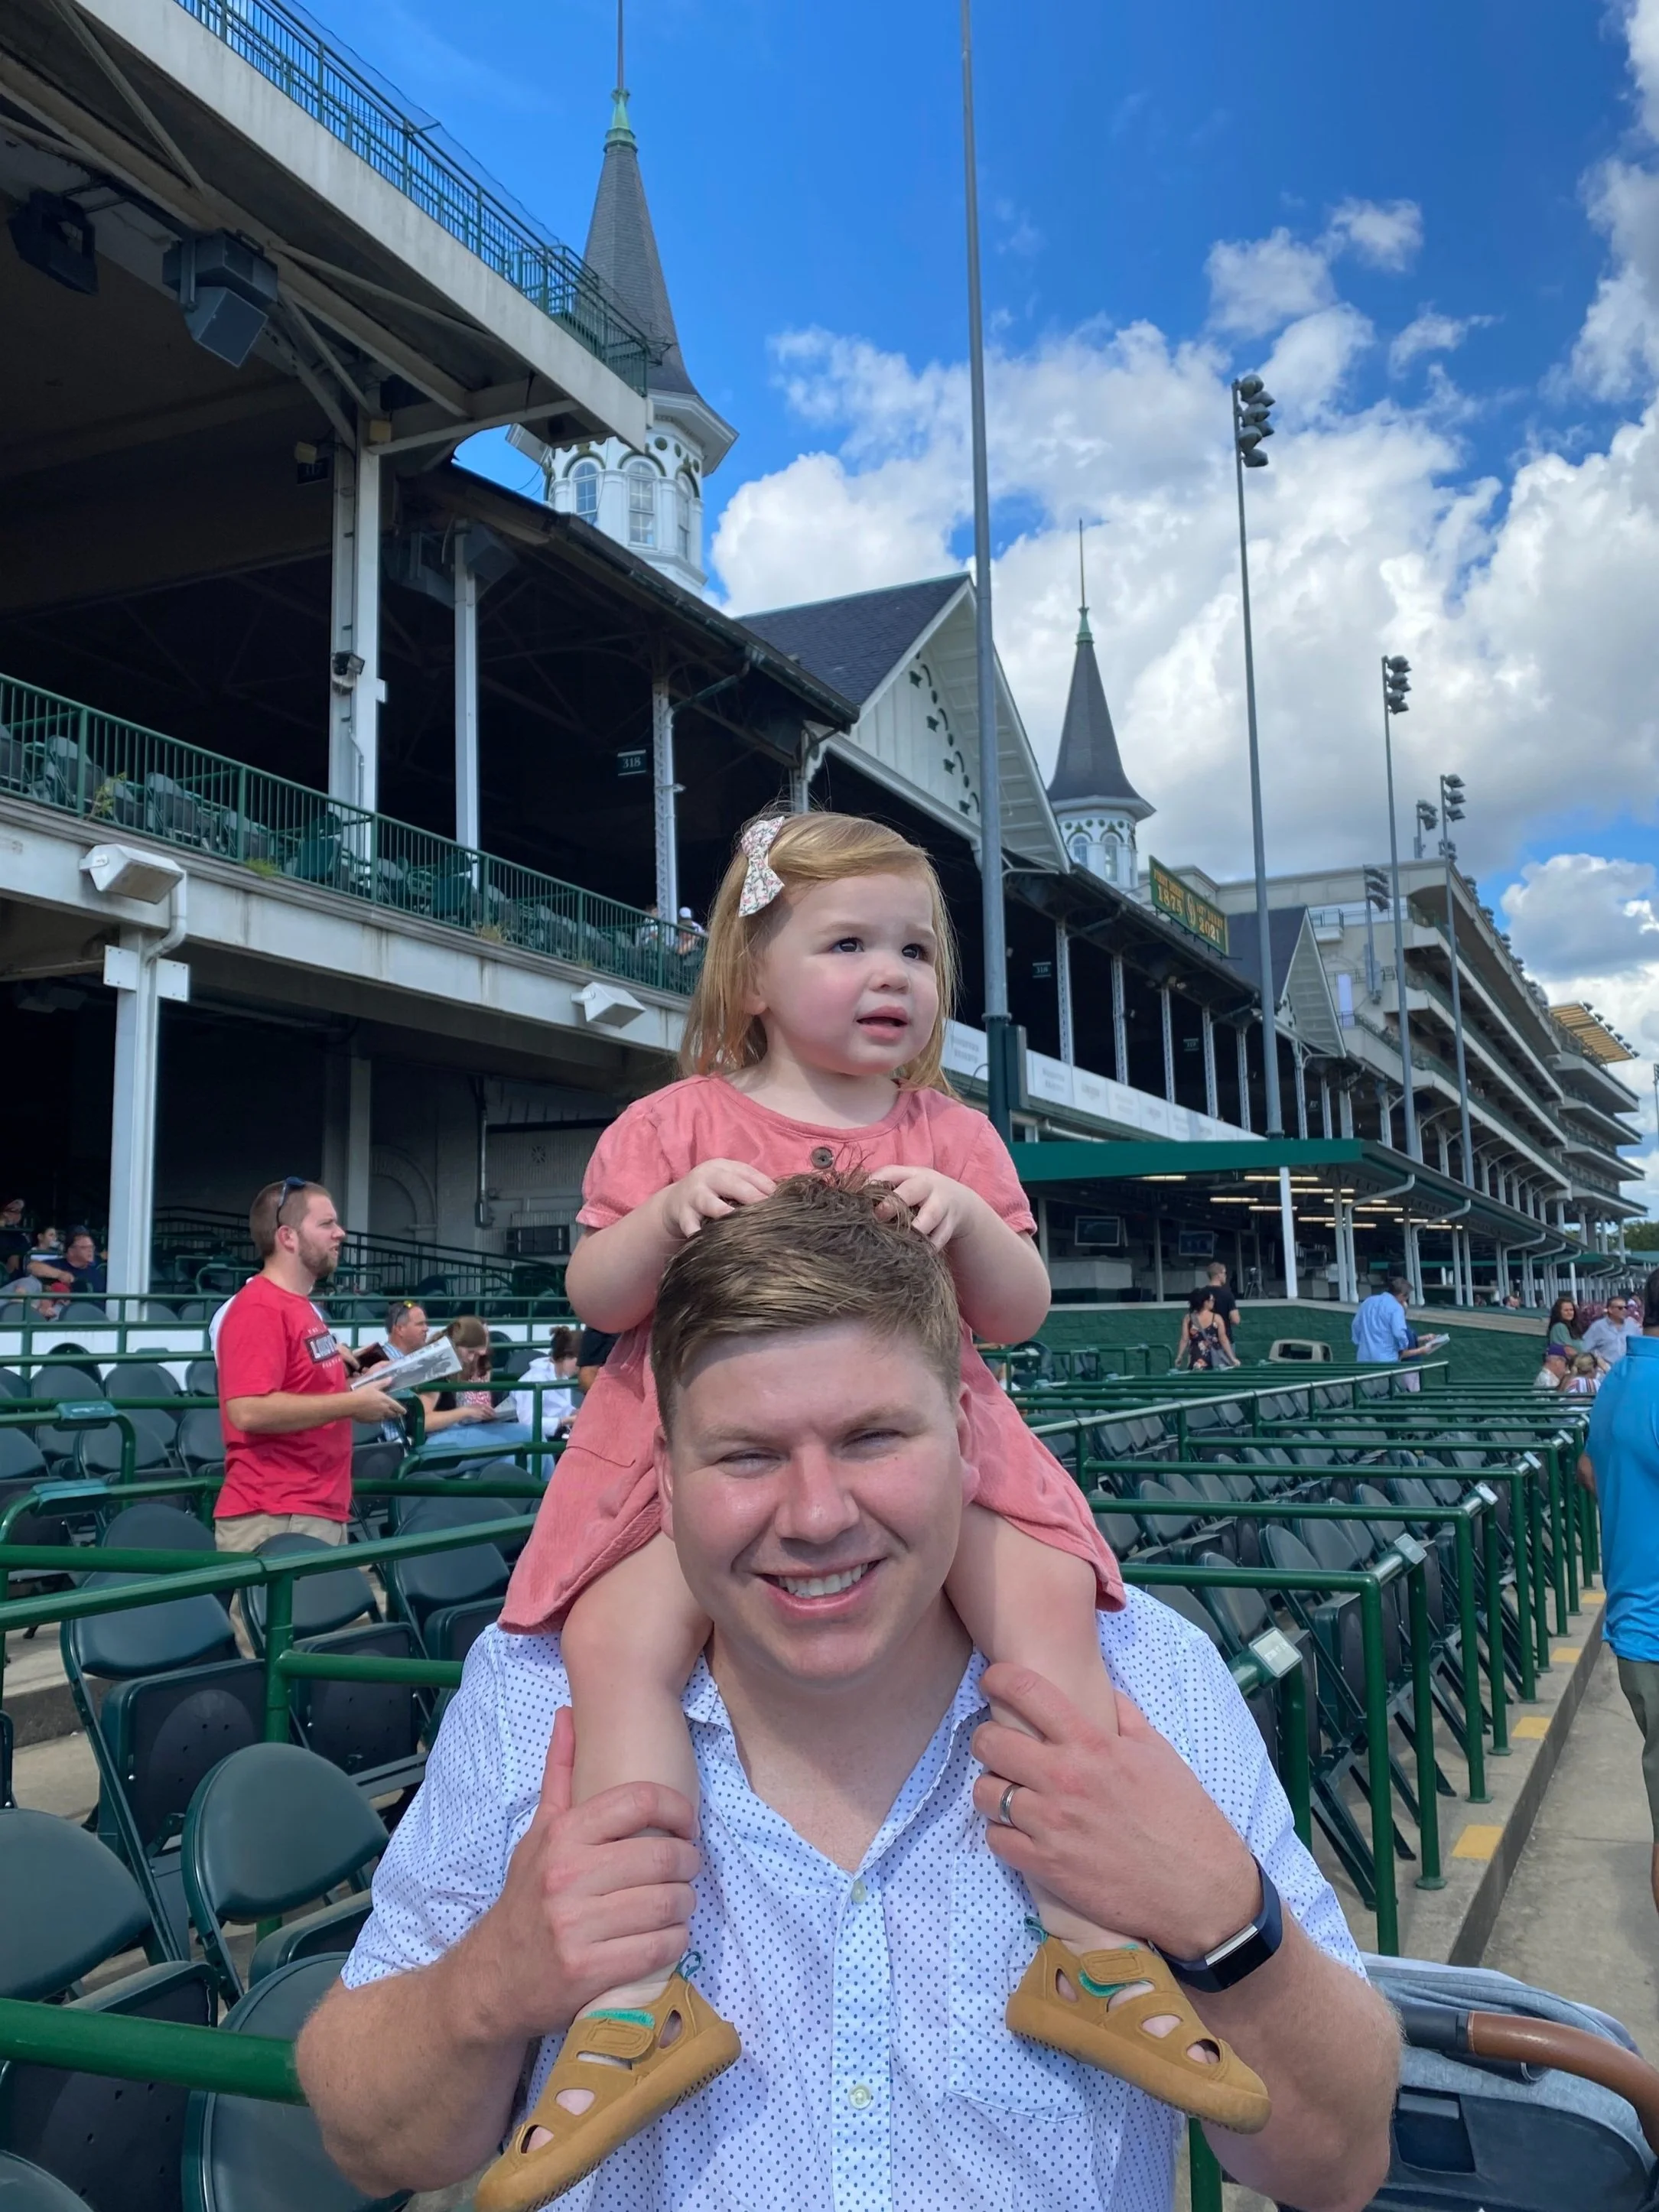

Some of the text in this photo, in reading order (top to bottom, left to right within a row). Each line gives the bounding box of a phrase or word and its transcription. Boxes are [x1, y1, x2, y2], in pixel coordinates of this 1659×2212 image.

[623, 756, 641, 769] 318
[1157, 884, 1182, 916] 1875
[1199, 916, 1220, 944] 2021
